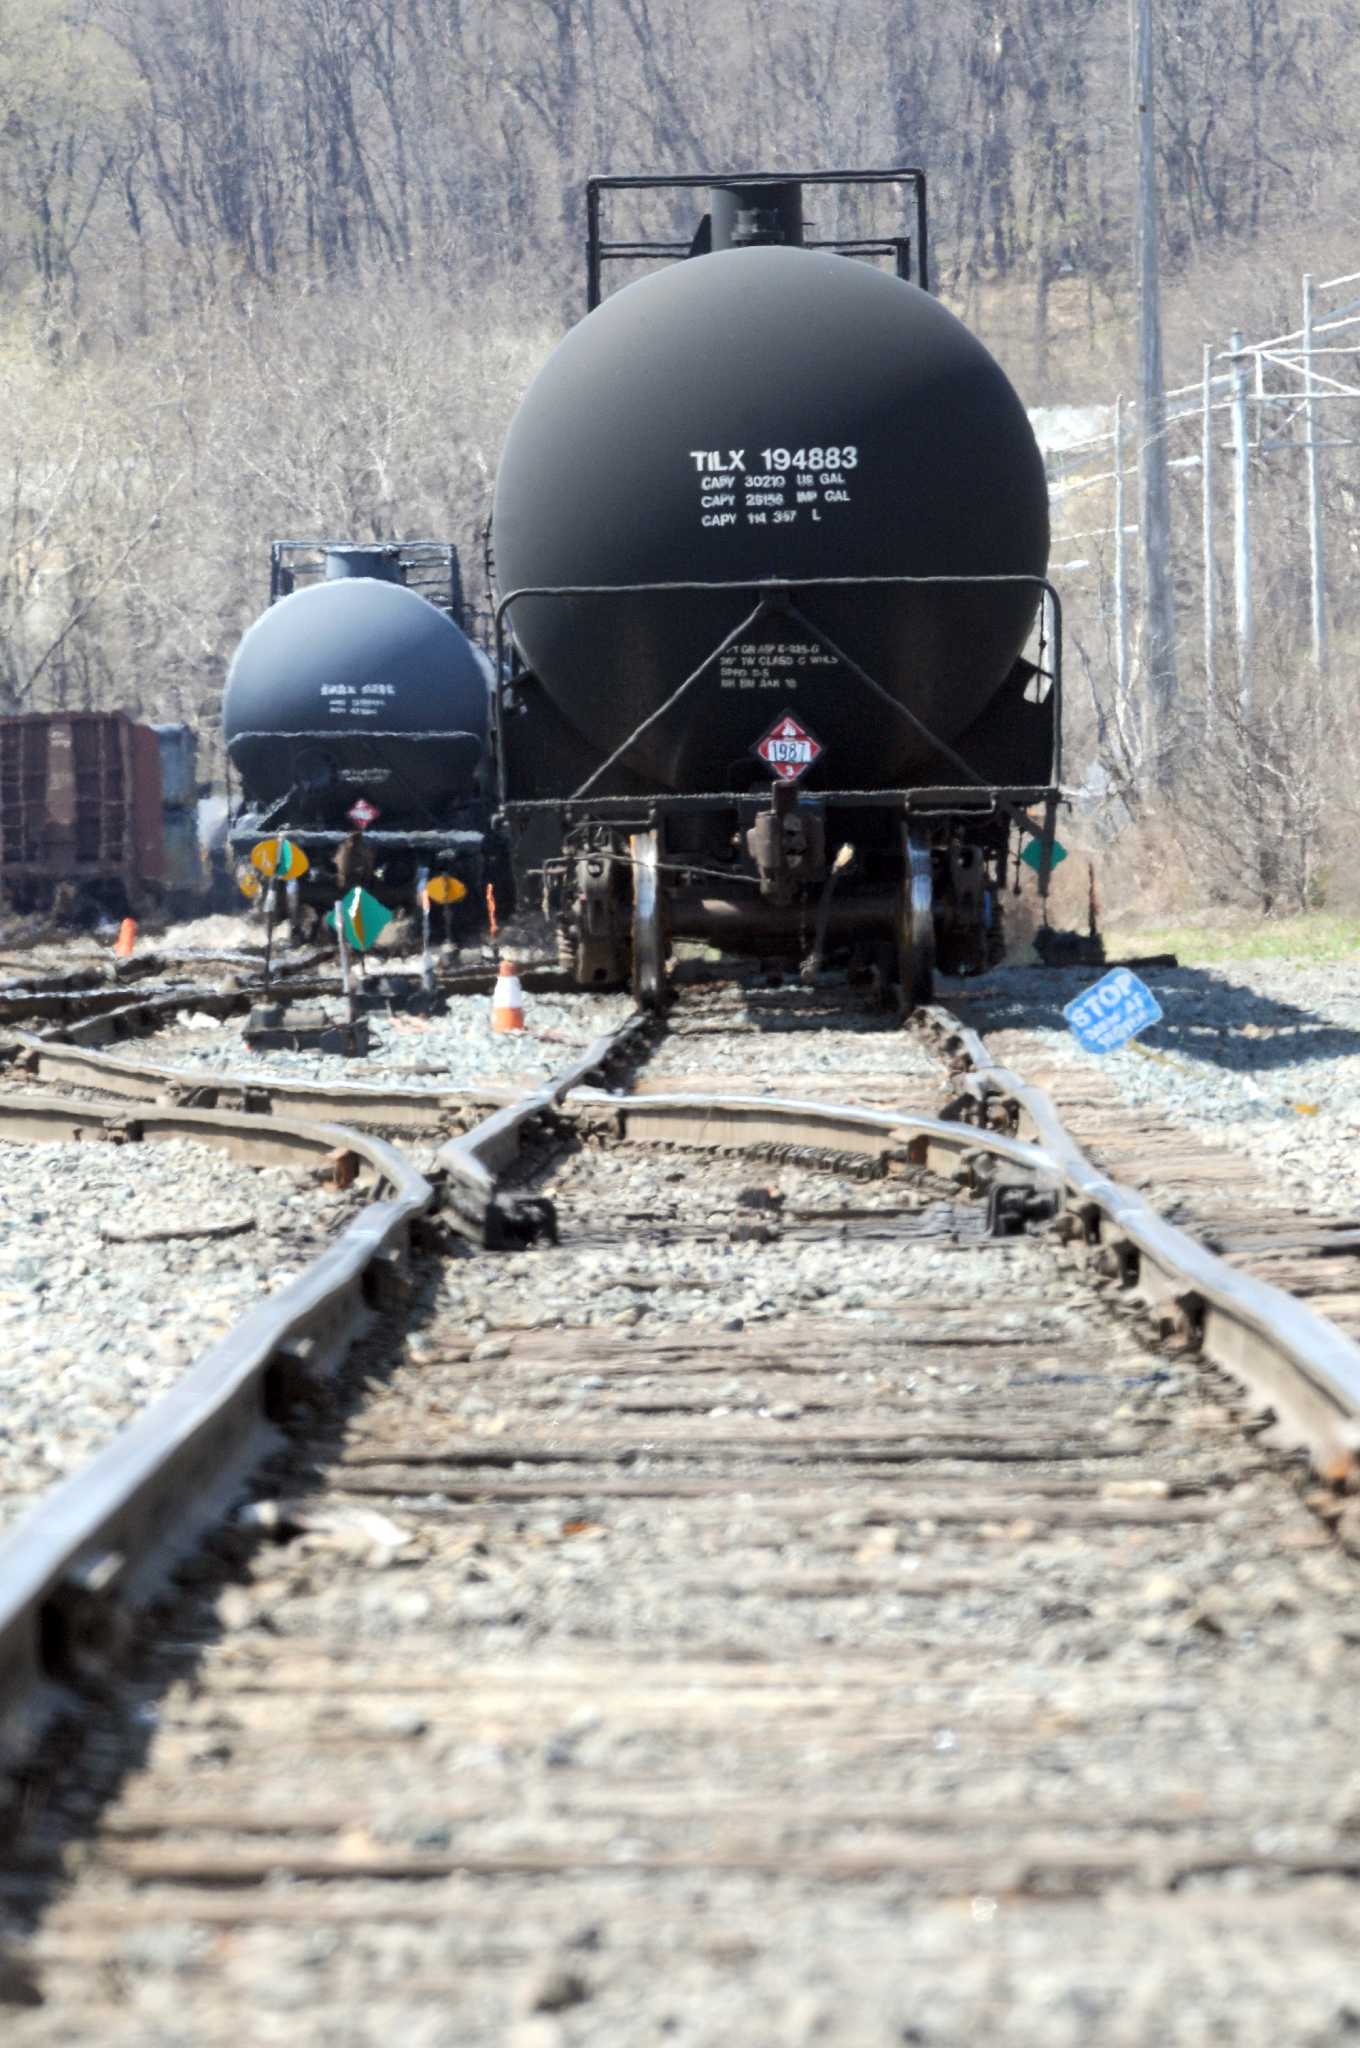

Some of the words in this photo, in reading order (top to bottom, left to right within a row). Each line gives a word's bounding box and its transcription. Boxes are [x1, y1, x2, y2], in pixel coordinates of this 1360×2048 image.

[690, 449, 746, 472] TILX
[760, 446, 858, 471] 194883
[701, 475, 735, 490] CAPY
[744, 475, 786, 488] 30210
[819, 473, 845, 485] GAL
[701, 494, 736, 508] CAPY
[824, 490, 850, 502] GAL
[701, 513, 737, 527] CAPY
[811, 508, 821, 521] L
[773, 743, 806, 762] 1987
[1072, 974, 1132, 1028] STOP
